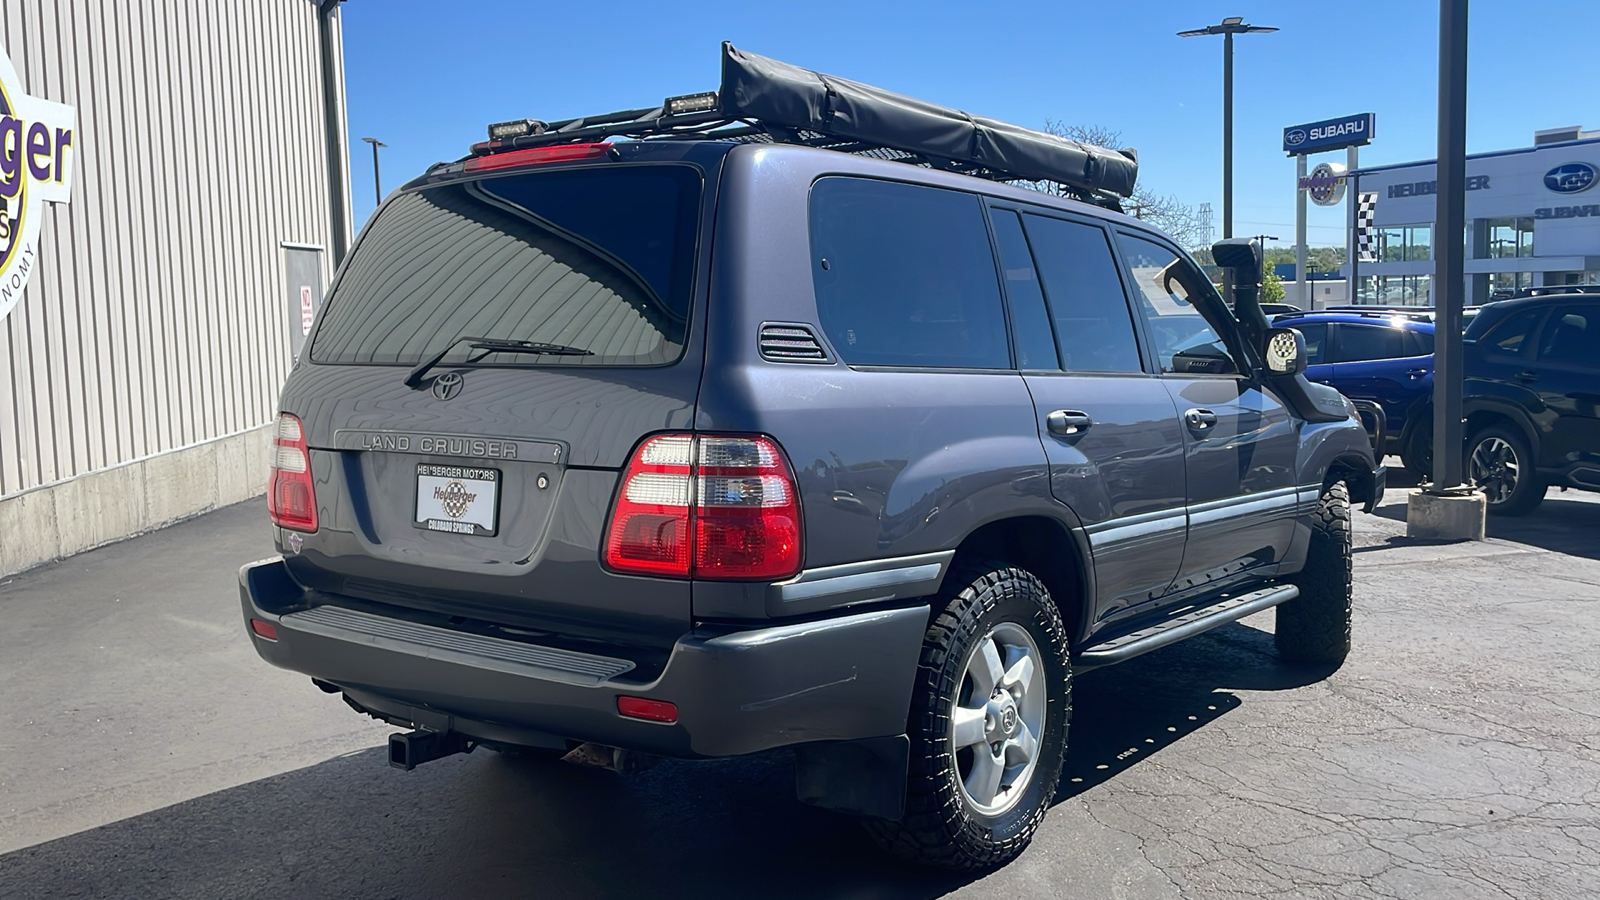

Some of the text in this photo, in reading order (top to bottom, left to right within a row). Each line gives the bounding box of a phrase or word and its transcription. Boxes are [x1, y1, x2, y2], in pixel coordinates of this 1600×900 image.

[1309, 120, 1364, 140] SUBARU
[1387, 175, 1491, 198] HEUBER
[361, 434, 519, 459] LAND CRUISER
